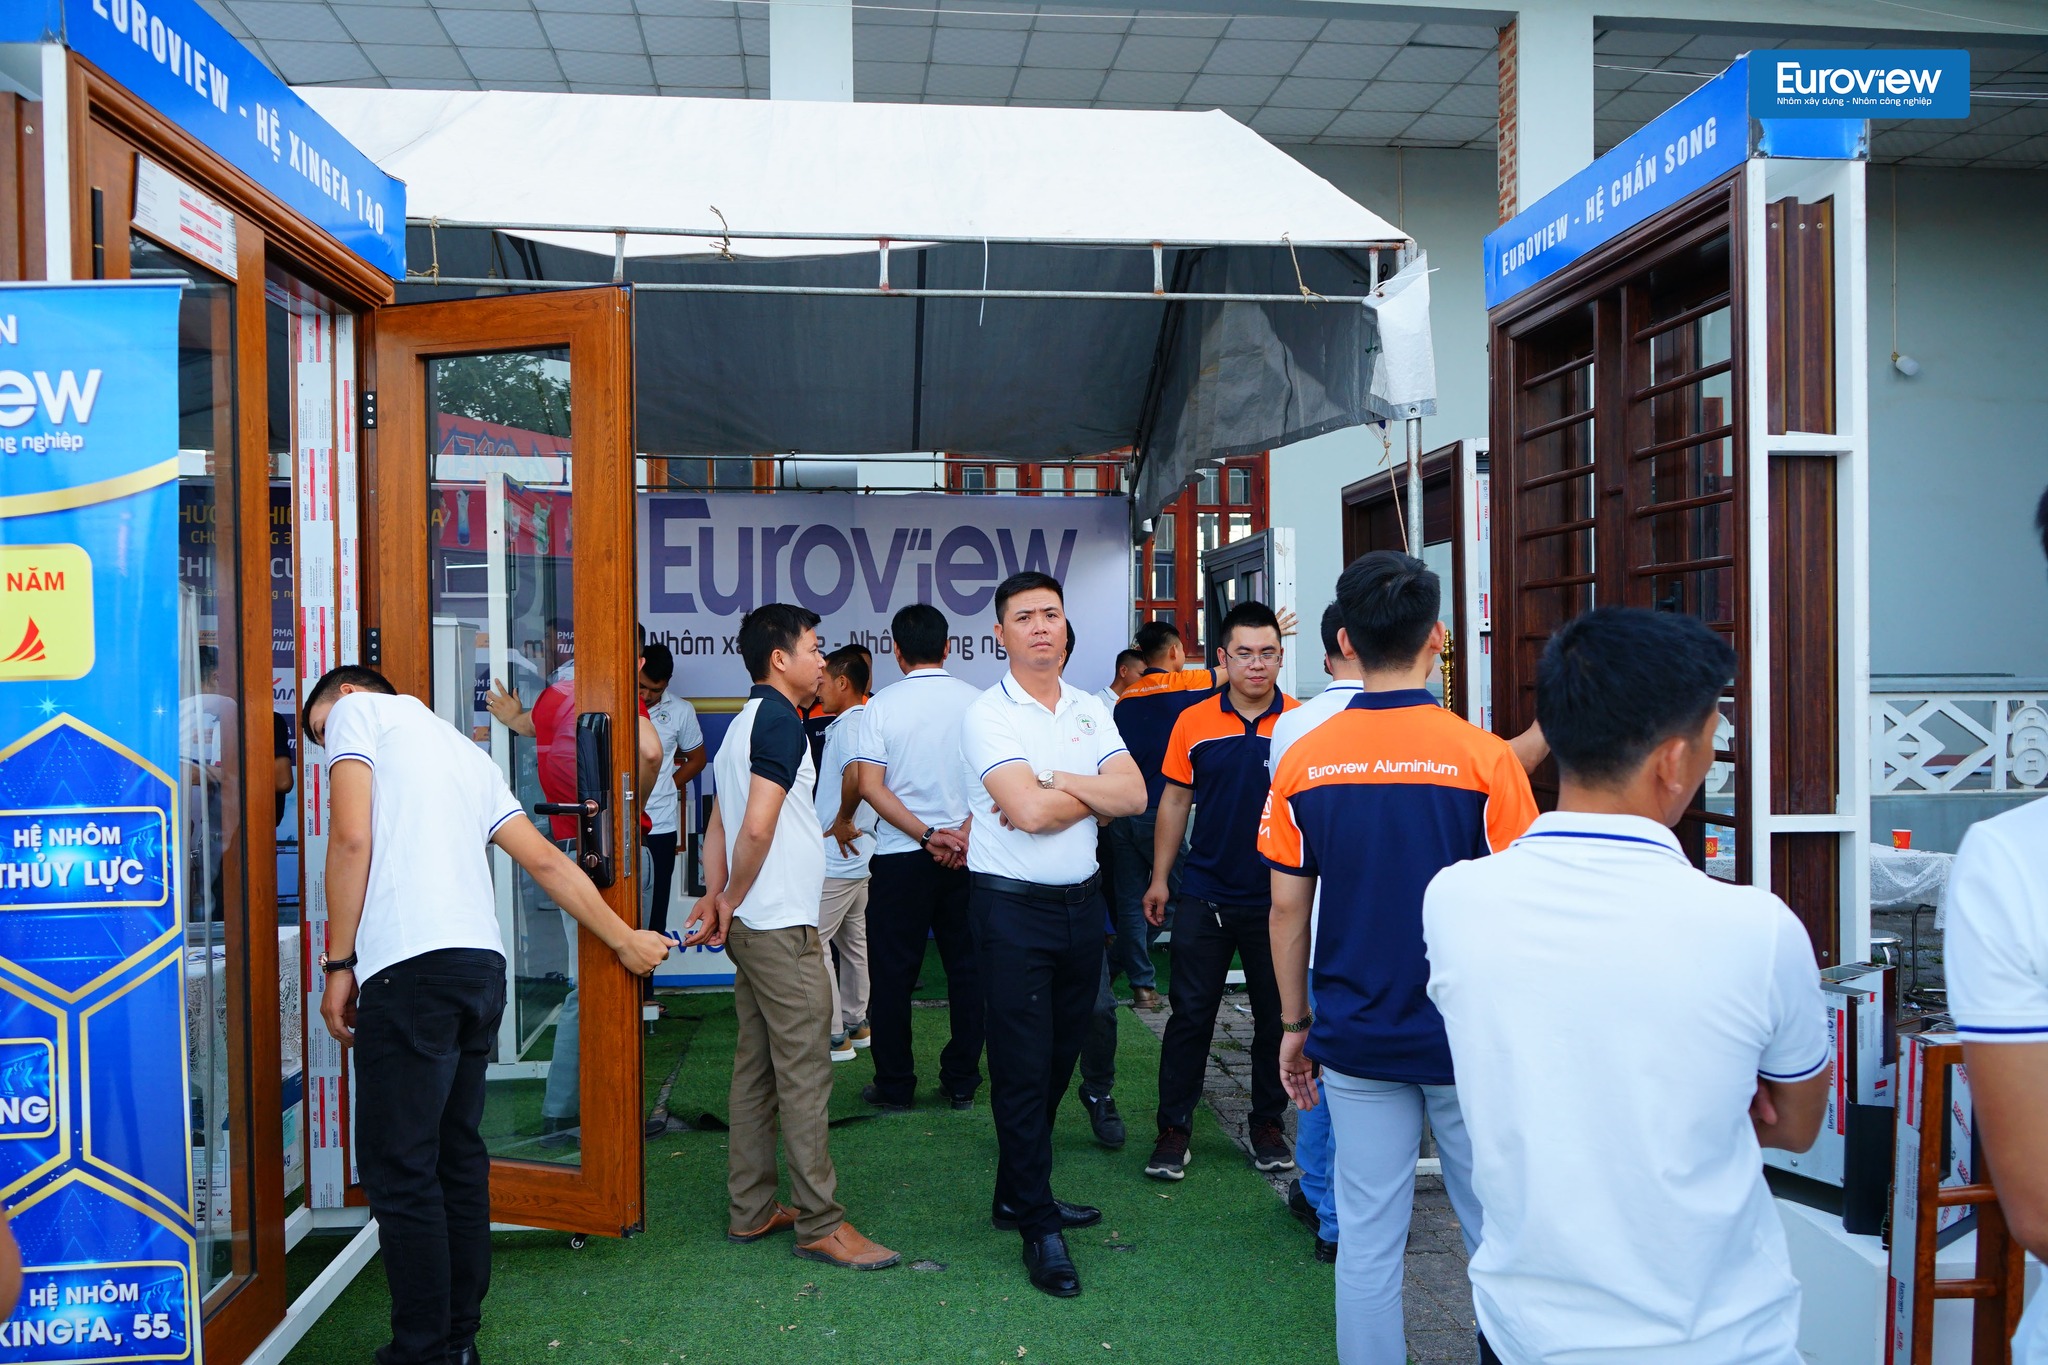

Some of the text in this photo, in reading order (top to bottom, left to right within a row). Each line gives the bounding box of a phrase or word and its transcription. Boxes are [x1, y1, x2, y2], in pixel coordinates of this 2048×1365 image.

[93, 0, 229, 114] UROVIEW
[256, 102, 281, 164] HỆ
[289, 129, 350, 211] XINGFA
[357, 188, 384, 236] 140
[1502, 213, 1568, 277] EUROVIEW
[1586, 185, 1604, 224] HỆ
[1611, 153, 1657, 208] CHẤN
[1664, 116, 1717, 175] SONG
[22, 431, 84, 453] nghiệp
[648, 498, 1078, 617] Euroview
[7, 566, 64, 592] NĂM
[650, 629, 714, 656] Nhôm
[1308, 759, 1458, 780] Euroview Aluminium
[14, 821, 121, 852] HỆ NHÔM
[83, 855, 144, 893] LỰC
[30, 1279, 139, 1311] HỆ NHÔM
[133, 1313, 171, 1340] 55
